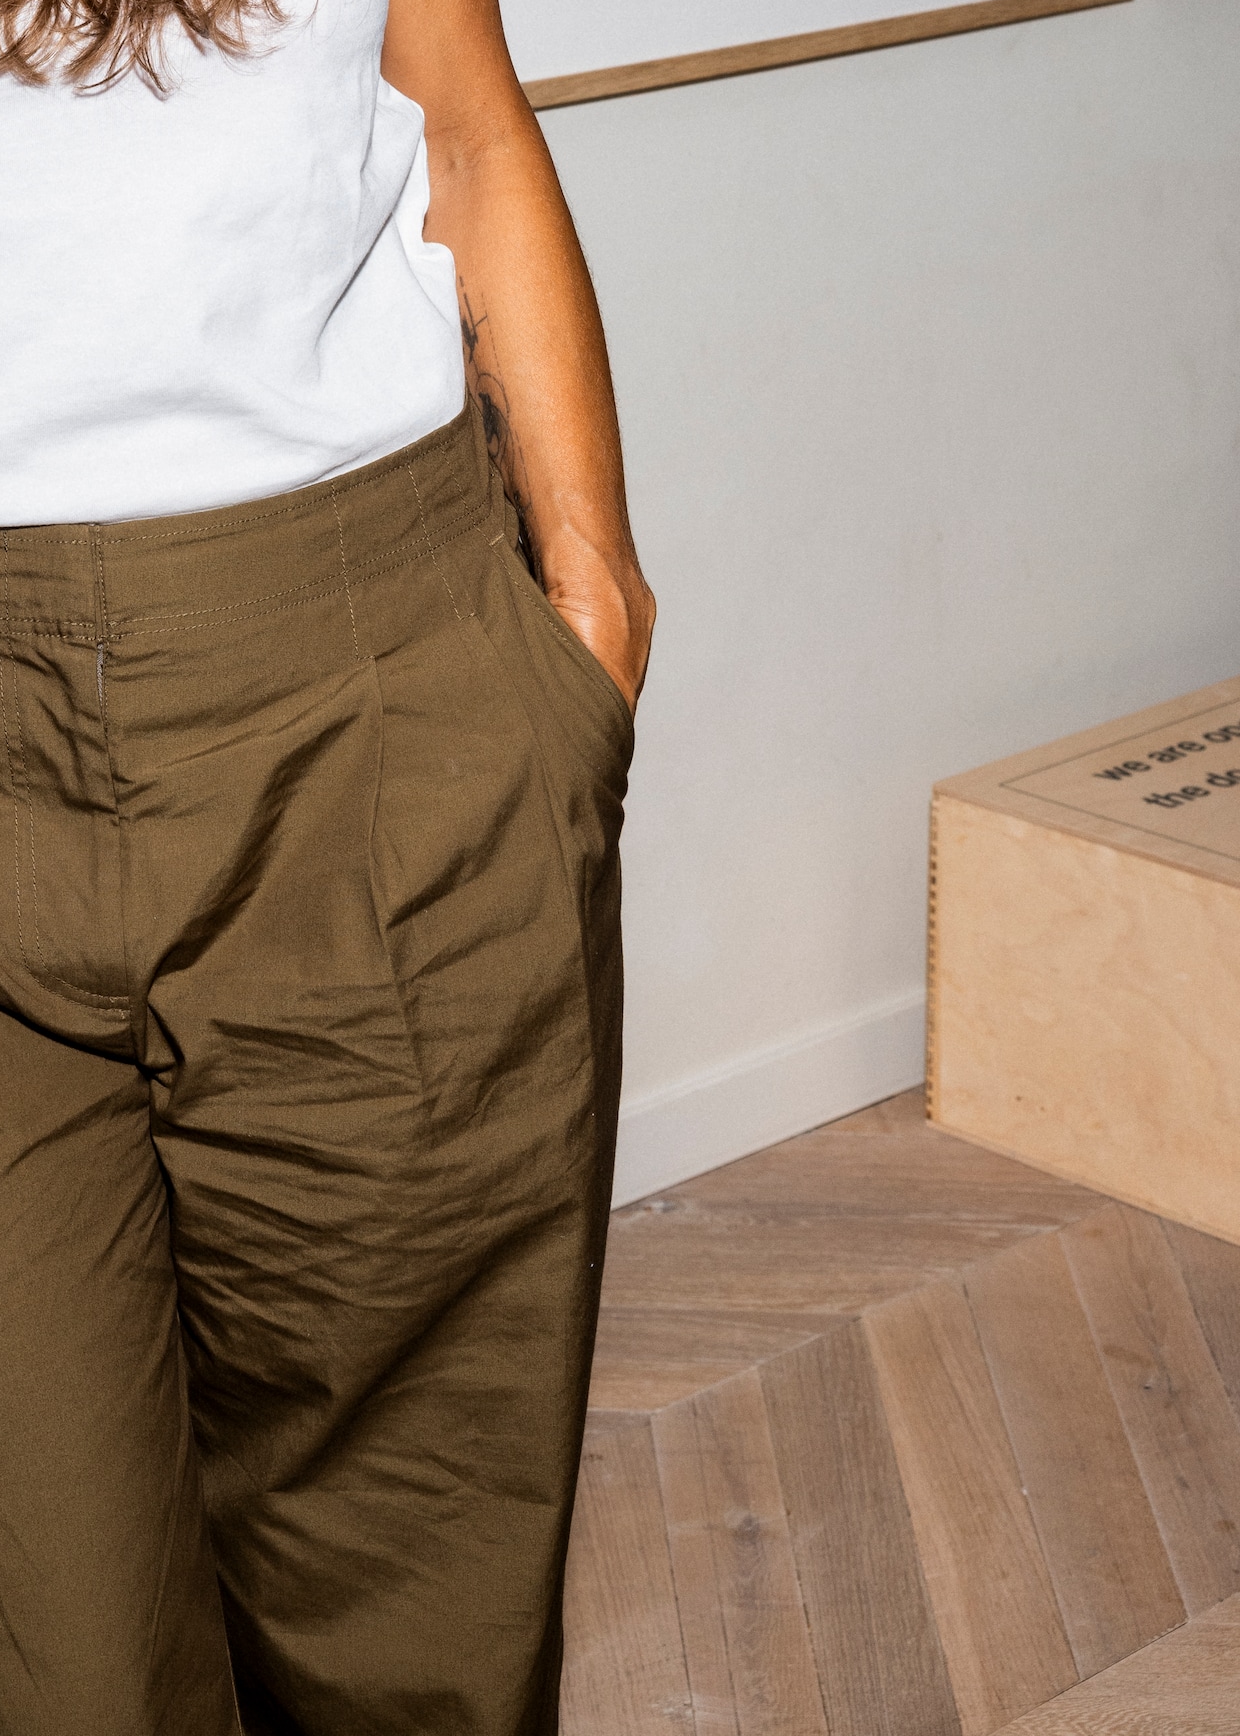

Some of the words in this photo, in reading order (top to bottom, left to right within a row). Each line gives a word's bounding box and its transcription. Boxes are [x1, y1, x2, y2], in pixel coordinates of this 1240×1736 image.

[1092, 760, 1151, 781] we
[1147, 740, 1207, 763] are
[1143, 785, 1211, 808] the
